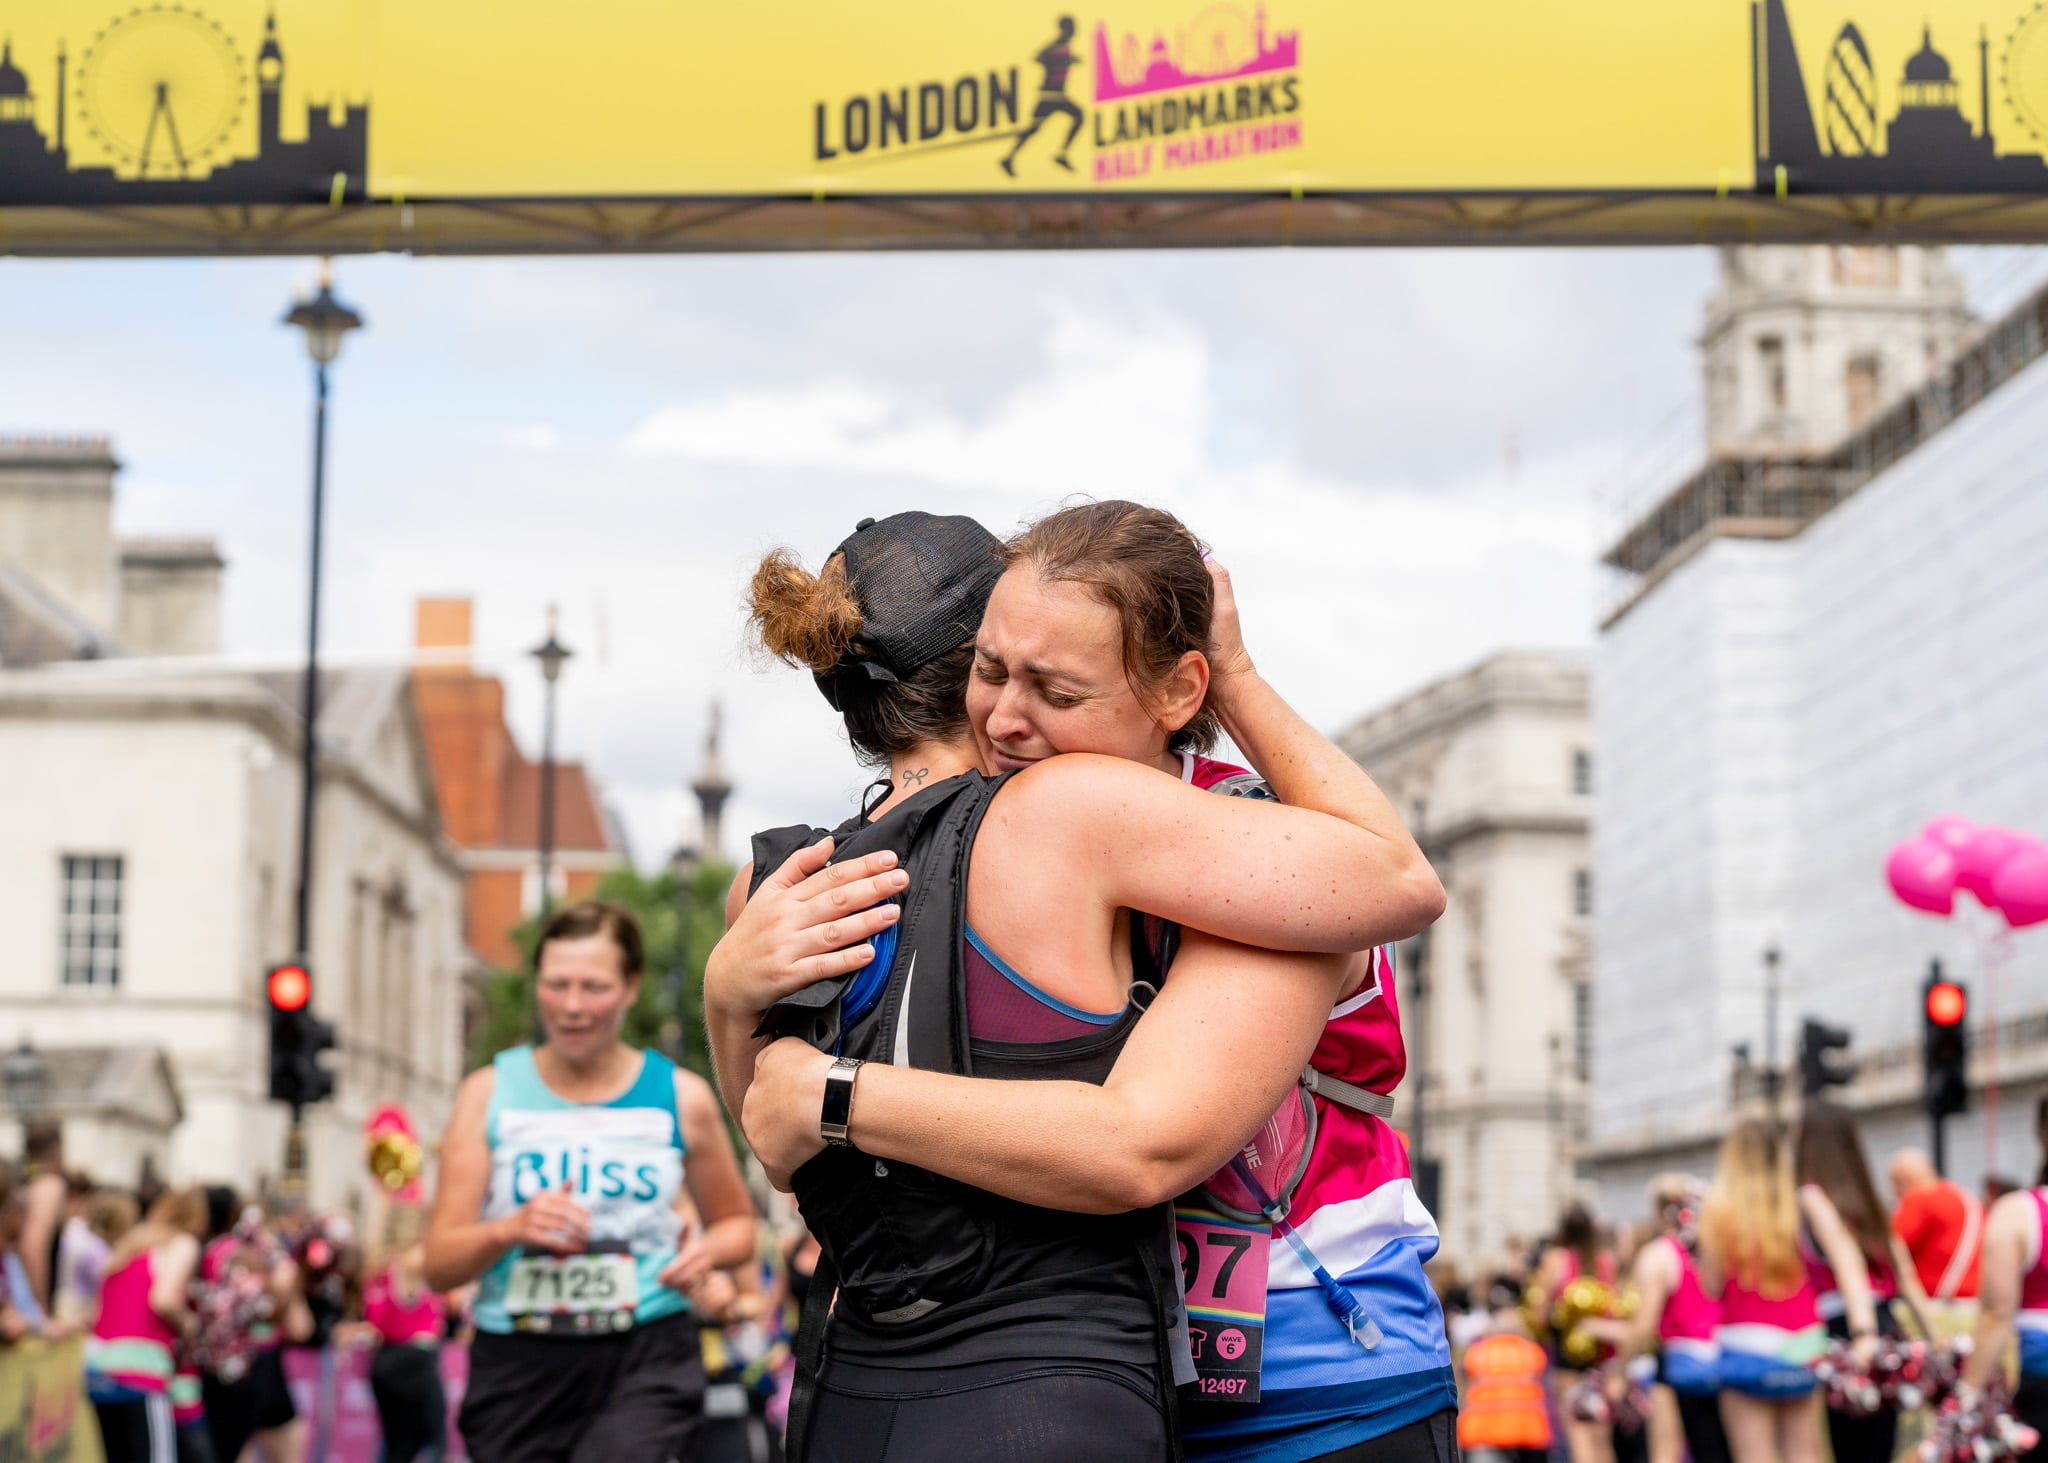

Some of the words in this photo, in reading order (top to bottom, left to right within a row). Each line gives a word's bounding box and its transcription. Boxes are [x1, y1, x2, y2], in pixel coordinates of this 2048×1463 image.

[815, 66, 1019, 161] LONDON
[1094, 76, 1300, 147] LANDMARKS
[1093, 143, 1153, 182] HALF
[1164, 119, 1301, 169] MARATHON
[513, 1147, 659, 1204] Bliss
[526, 1266, 617, 1299] 7125
[1226, 1343, 1235, 1355] 6
[1199, 1378, 1247, 1394] 12497
